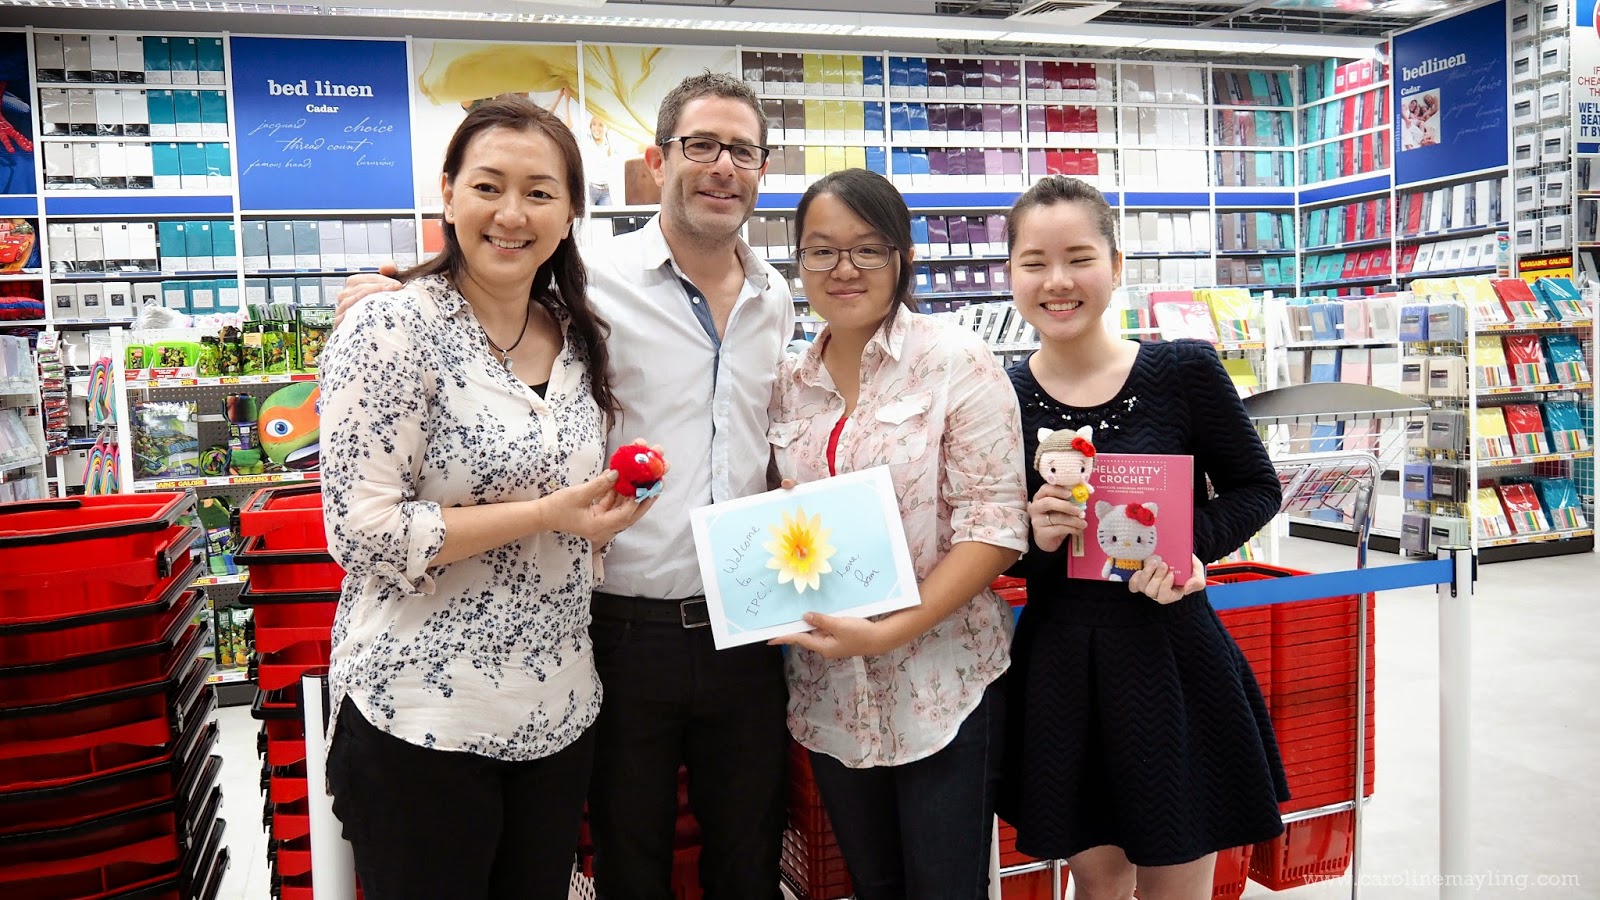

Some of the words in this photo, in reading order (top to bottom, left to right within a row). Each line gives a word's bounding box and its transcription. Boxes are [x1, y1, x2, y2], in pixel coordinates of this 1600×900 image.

[1402, 53, 1467, 81] bedlinen
[267, 80, 309, 96] bed
[315, 80, 374, 97] linen
[1401, 85, 1421, 96] Cadar
[306, 103, 339, 113] Cadar
[247, 118, 307, 137] jacquard
[343, 117, 394, 133] choice
[1580, 126, 1589, 137] IT
[275, 137, 325, 152] thread
[326, 138, 373, 152] count
[1520, 260, 1547, 268] BARGAINS
[1549, 257, 1569, 265] GALORE
[1092, 465, 1126, 474] HELLO
[1129, 466, 1161, 475] KITTY
[177, 479, 205, 487] GALORE
[233, 475, 269, 483] BARGAINS
[1099, 475, 1152, 485] CROCHET
[723, 526, 761, 574] Welcome
[837, 554, 860, 578] Love,
[736, 576, 752, 588] to
[746, 582, 772, 616] IPC!
